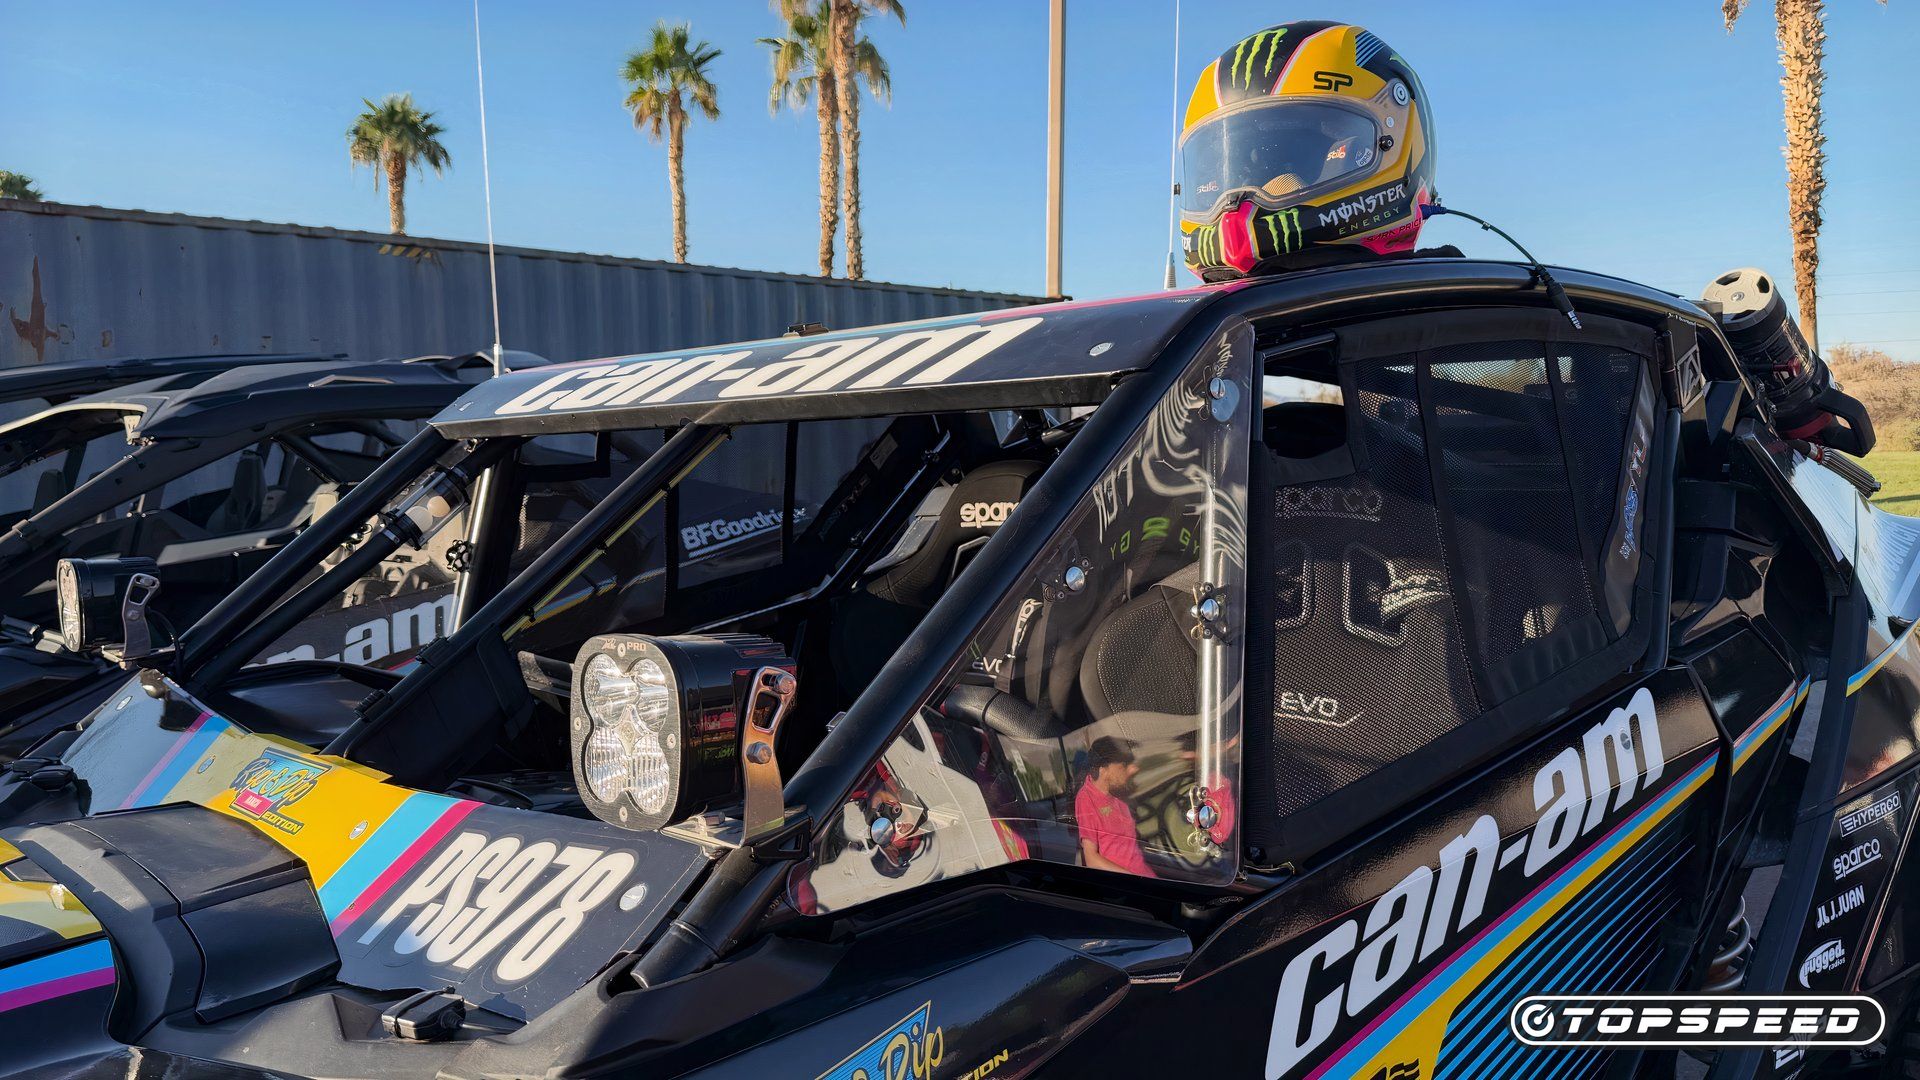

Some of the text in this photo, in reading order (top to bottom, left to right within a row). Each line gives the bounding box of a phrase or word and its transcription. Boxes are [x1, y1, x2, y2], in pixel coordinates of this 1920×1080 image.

[1313, 71, 1353, 91] SP
[1318, 184, 1406, 227] MONSTER
[1338, 206, 1401, 235] ENERGY
[495, 317, 1044, 415] can-am
[960, 502, 1019, 528] spar
[626, 641, 647, 651] PRO
[1281, 691, 1339, 718] EVO
[261, 811, 302, 833] EDITION
[1833, 838, 1881, 879] sparco
[1265, 687, 1664, 1080] can-am
[356, 831, 635, 981] PS978
[1828, 957, 1846, 971] radios
